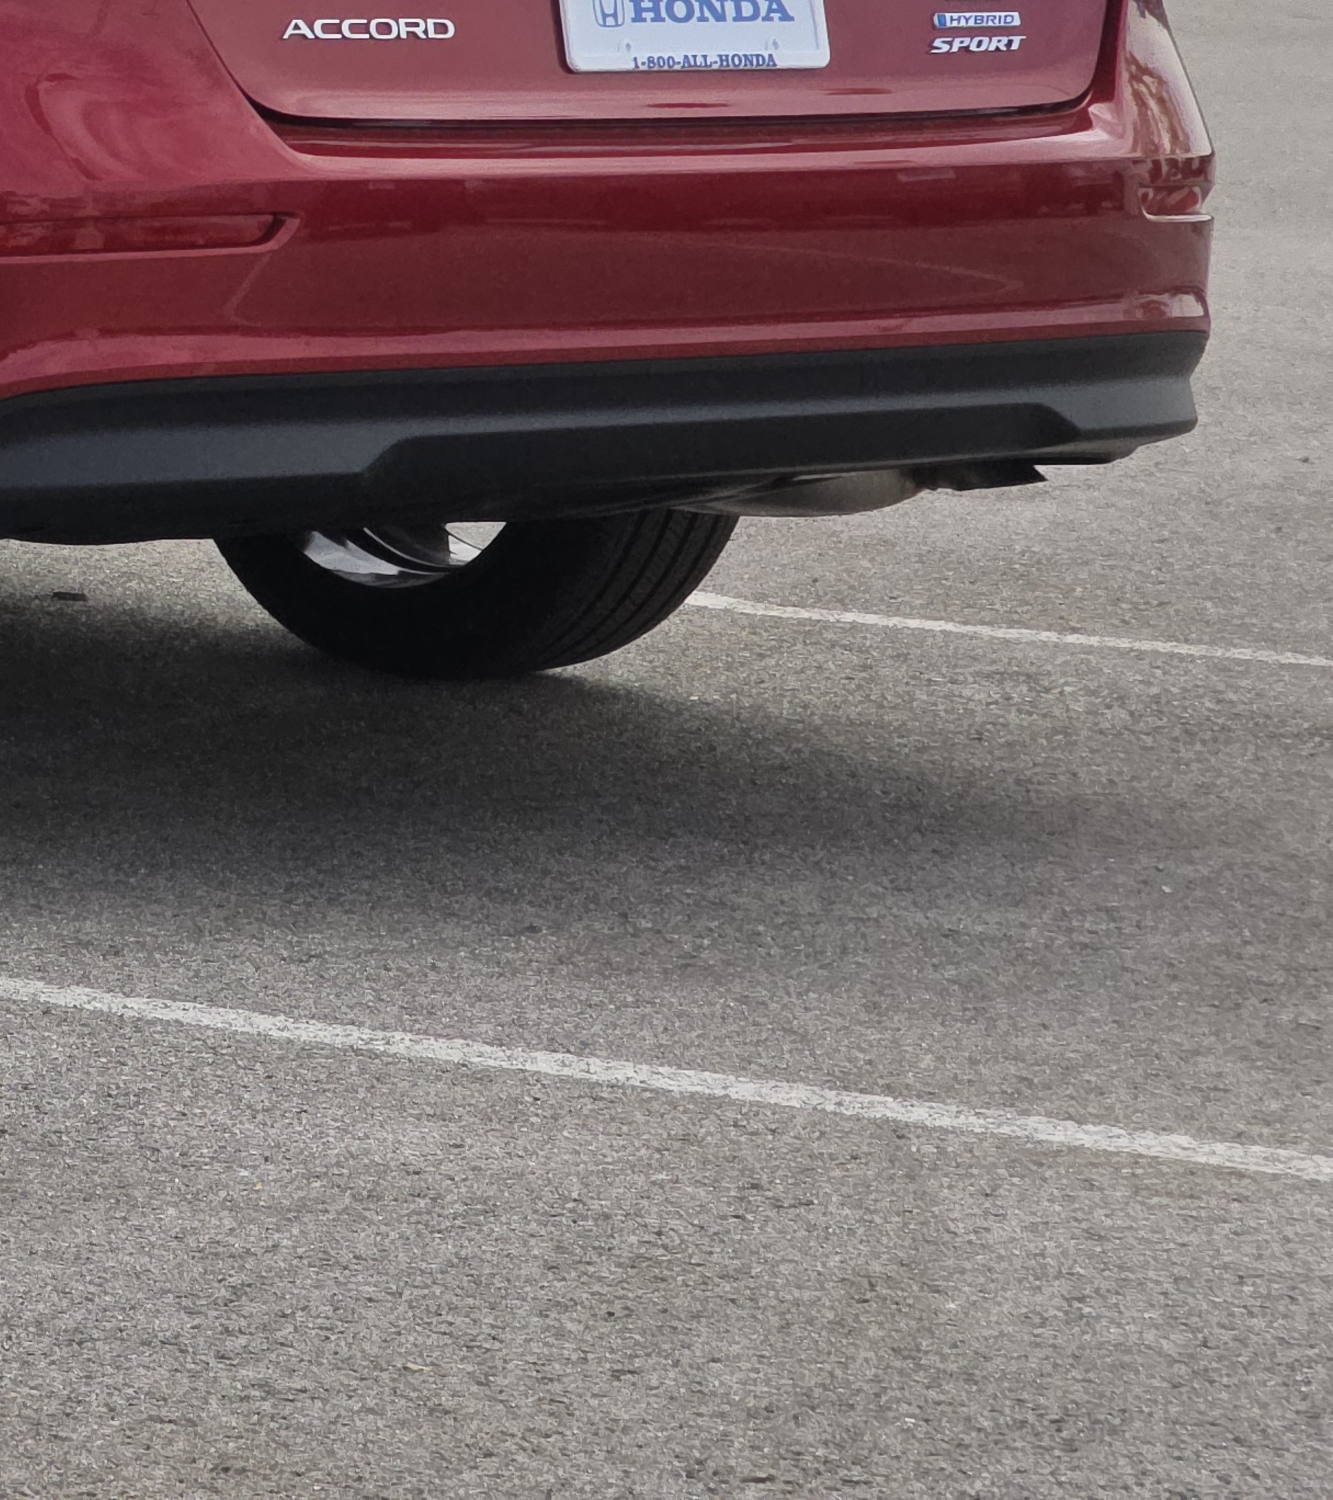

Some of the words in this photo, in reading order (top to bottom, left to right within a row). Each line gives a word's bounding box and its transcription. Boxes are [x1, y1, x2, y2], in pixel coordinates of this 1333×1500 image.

[949, 14, 1015, 25] HYBRID
[282, 18, 455, 39] ACCORD
[930, 35, 1027, 53] SPORT
[633, 53, 778, 70] 1-800-ALL-HONDA
